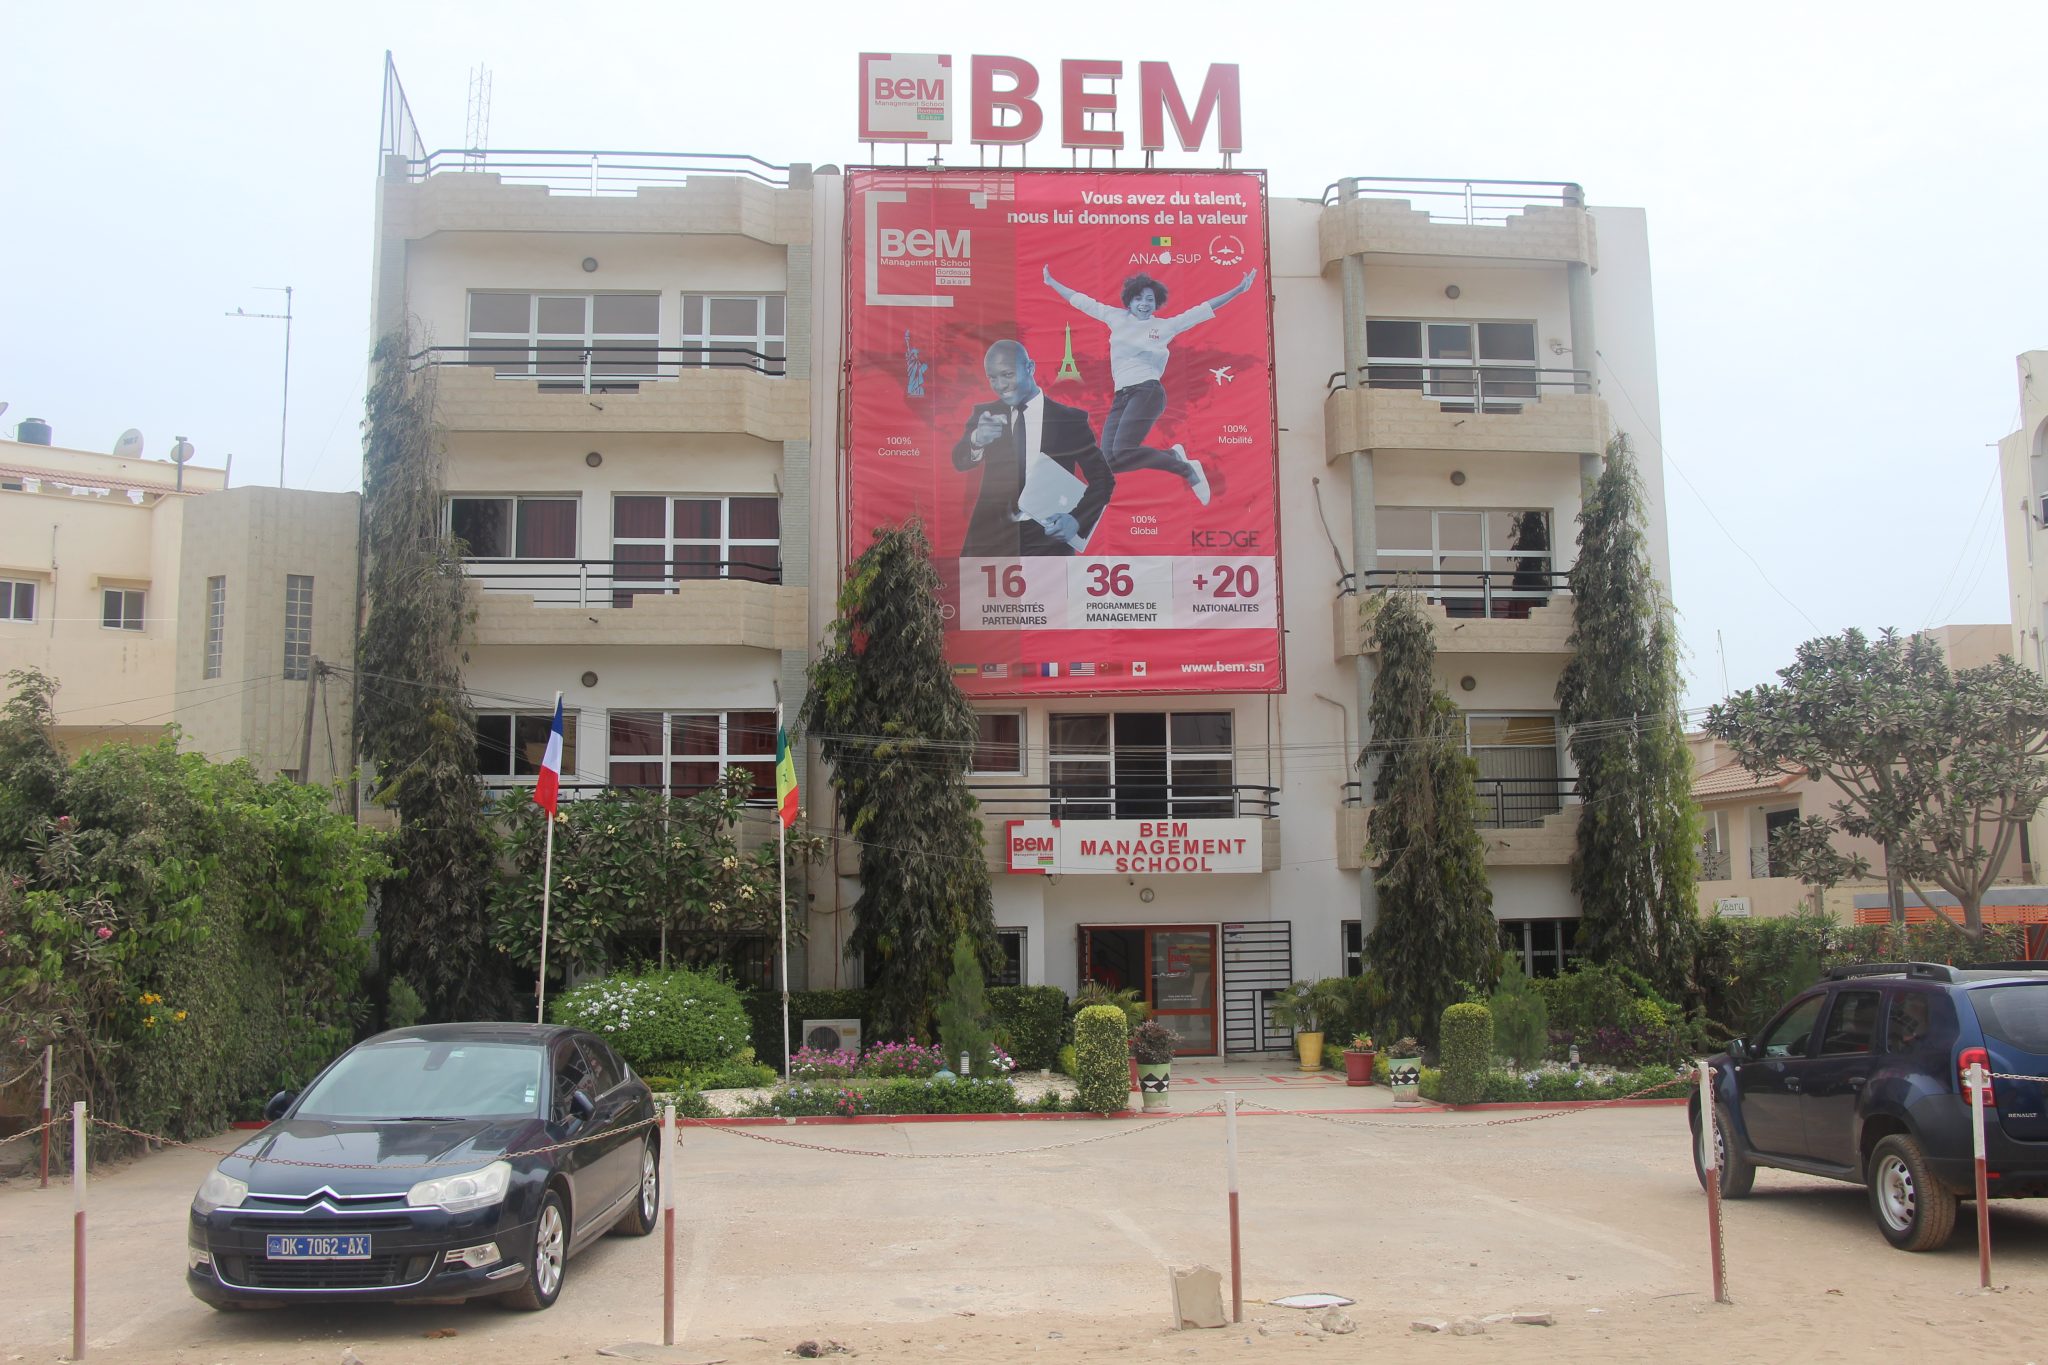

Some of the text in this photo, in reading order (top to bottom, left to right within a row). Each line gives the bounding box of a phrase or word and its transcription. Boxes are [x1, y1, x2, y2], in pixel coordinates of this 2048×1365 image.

[970, 53, 1242, 152] BEM
[1081, 191, 1247, 207] Vous avez du talent,
[1007, 210, 1248, 225] nous lui donnons de la valeur
[880, 258, 937, 267] Management
[1210, 255, 1242, 266] CAMES
[1222, 425, 1248, 433] 100%
[886, 437, 912, 445] 100%
[1218, 435, 1253, 444] Mobilité
[878, 447, 920, 456] Connecté
[1131, 516, 1157, 524] 100%
[1130, 527, 1158, 535] Global
[1191, 530, 1260, 548] KEDGE
[981, 565, 1026, 598] 16
[1086, 563, 1134, 597] 36
[1192, 564, 1259, 598] +20
[982, 602, 1044, 613] UNIVERSITÉS
[1086, 602, 1157, 610] PROGRAMMES DE
[982, 616, 1047, 625] PARTENAIRES
[1086, 613, 1158, 622] MANAGEMENT
[1181, 662, 1265, 673] www.bem.sn
[1140, 822, 1188, 838] BEM
[1080, 839, 1247, 856] MANAGEMENT
[1115, 857, 1213, 873] SCHOOL
